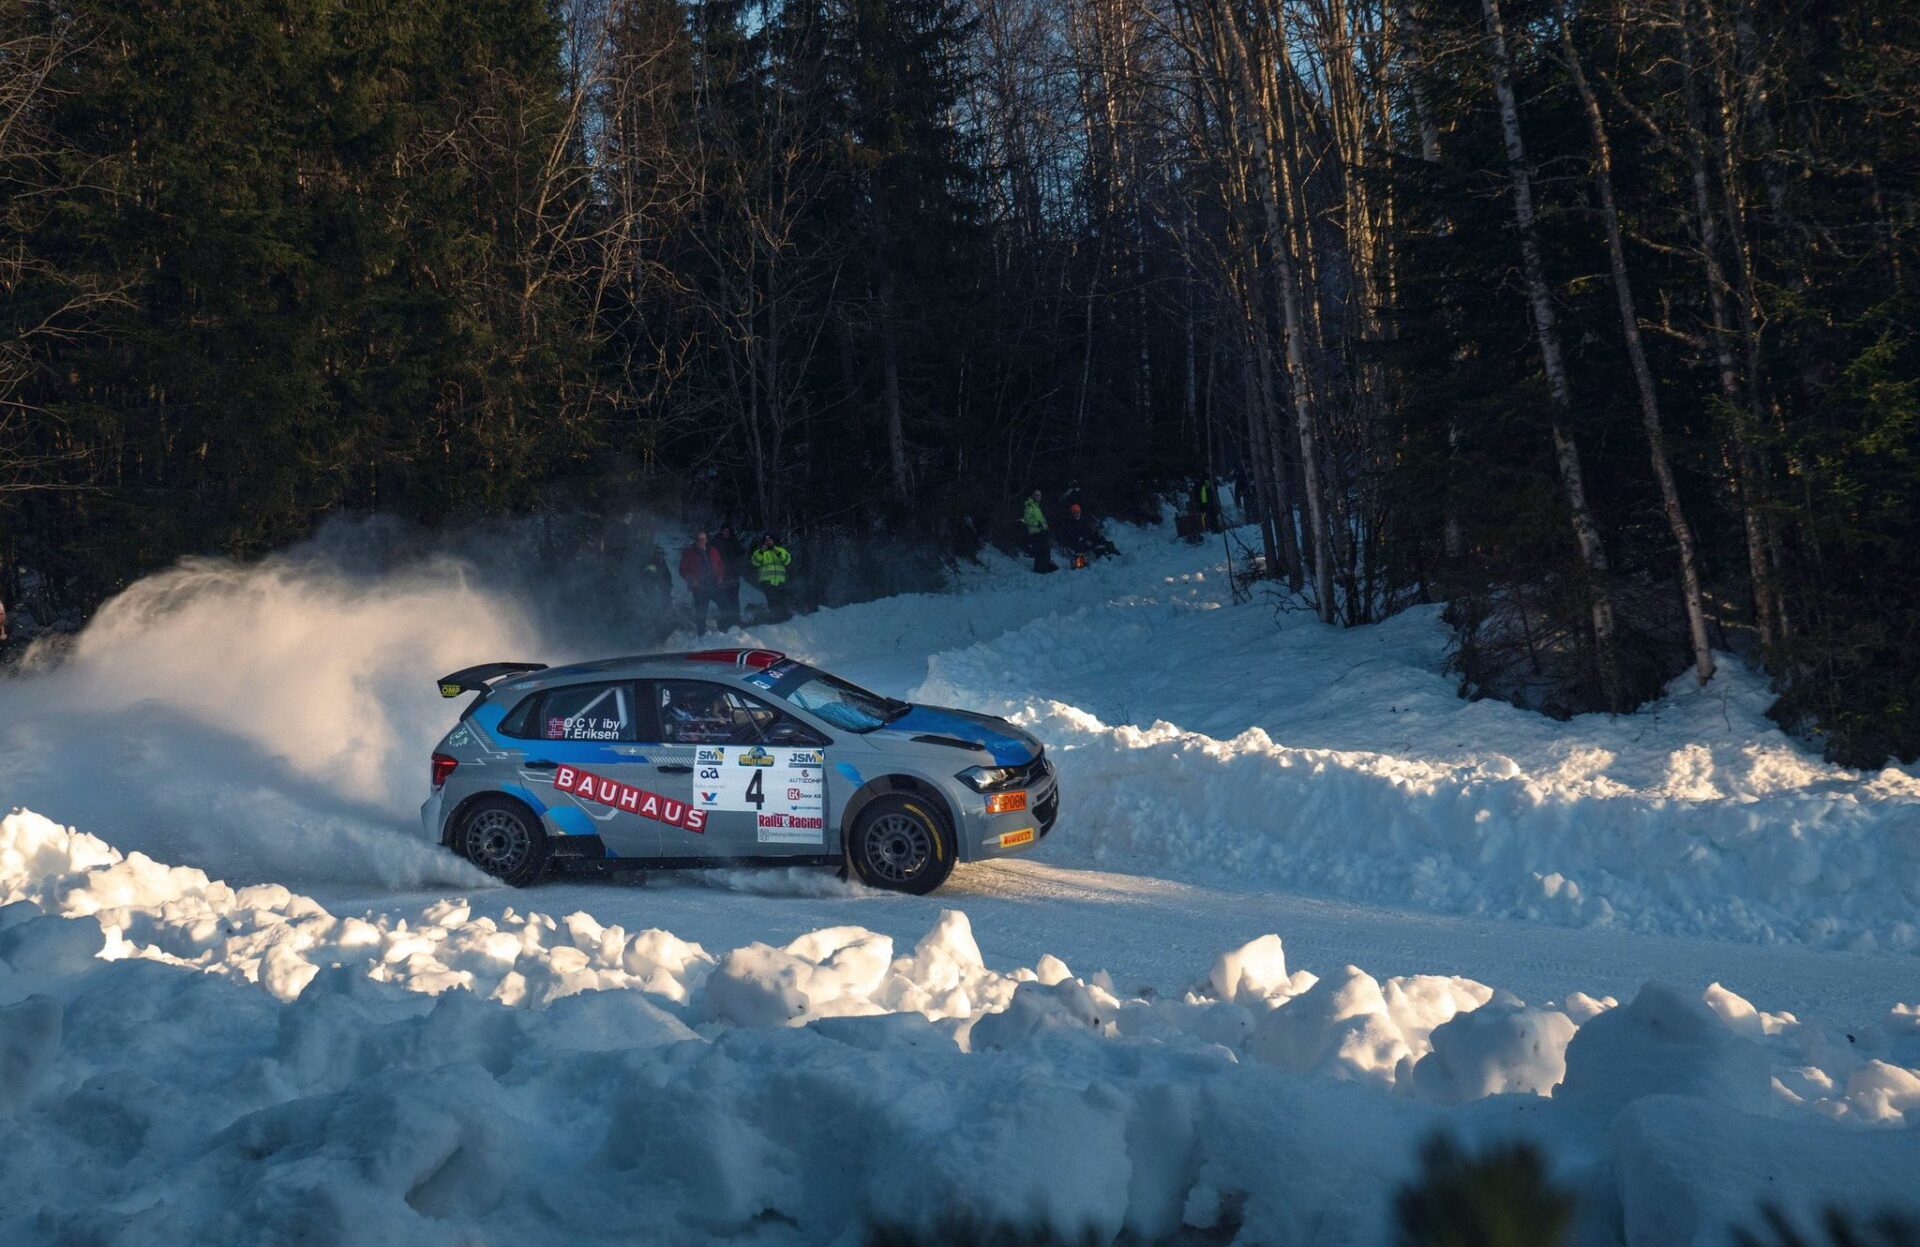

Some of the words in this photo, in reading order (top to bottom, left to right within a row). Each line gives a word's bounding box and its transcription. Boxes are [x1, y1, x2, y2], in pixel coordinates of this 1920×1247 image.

[442, 685, 460, 695] OMP
[563, 728, 619, 740] T.Eriksen
[698, 750, 718, 760] SM
[789, 753, 817, 763] JSM
[745, 769, 765, 810] 4
[788, 789, 800, 800] GK
[558, 767, 704, 828] BAUHAUS
[759, 814, 783, 828] Rally
[789, 815, 822, 829] Racing
[1004, 830, 1031, 845] PIRELLI
